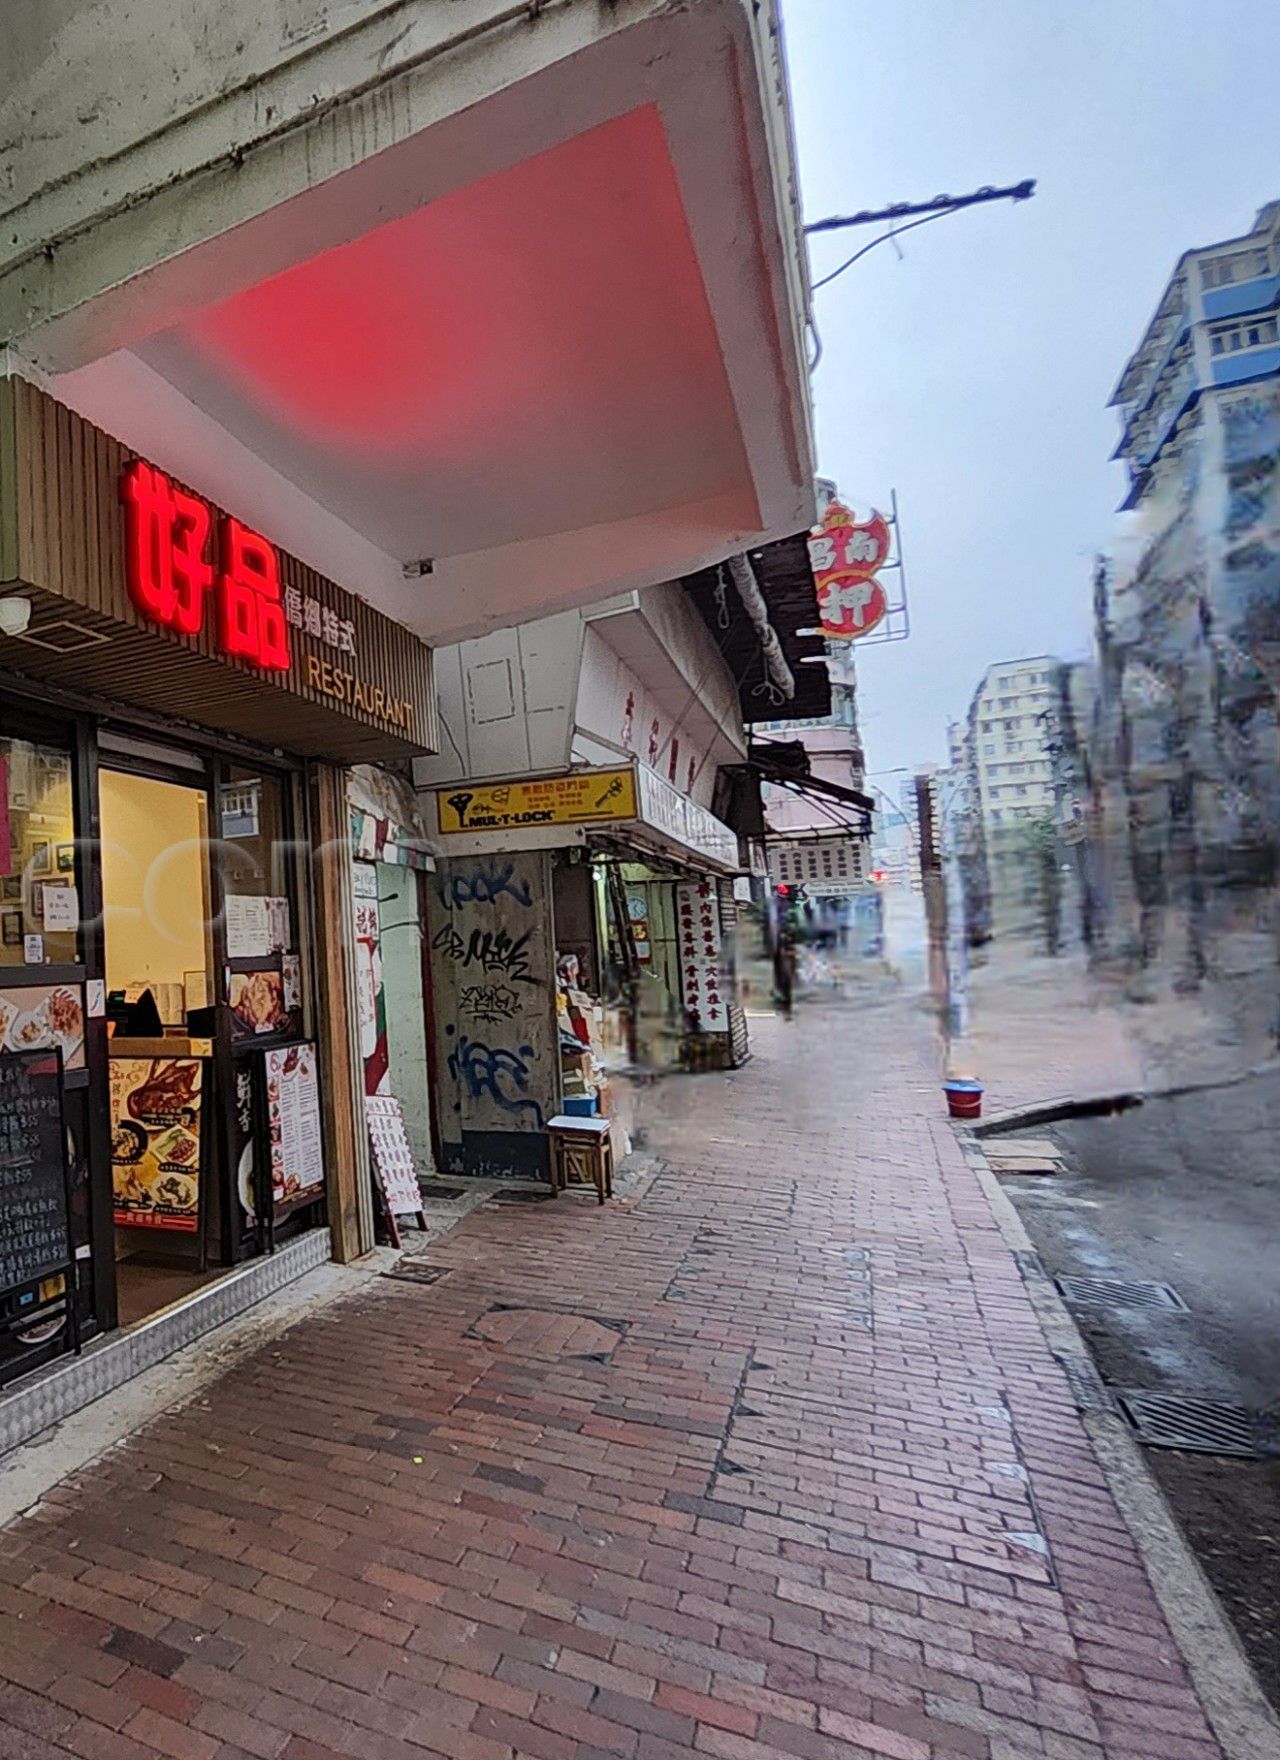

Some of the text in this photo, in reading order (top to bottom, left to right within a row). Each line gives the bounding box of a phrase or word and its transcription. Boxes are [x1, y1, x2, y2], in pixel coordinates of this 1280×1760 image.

[128, 459, 293, 673] 好品
[819, 580, 877, 628] 押
[307, 655, 413, 729] RESTAURANT
